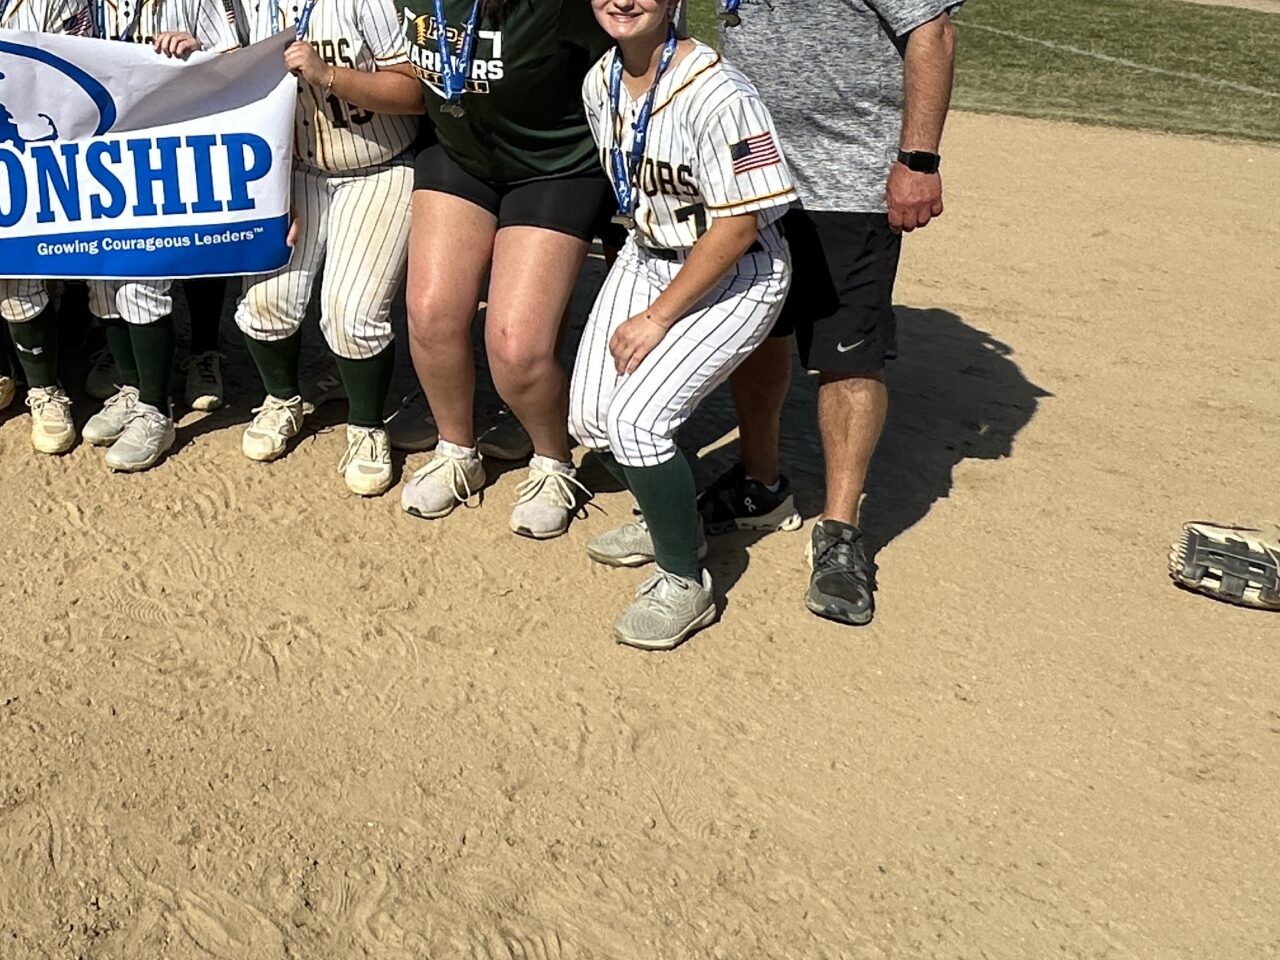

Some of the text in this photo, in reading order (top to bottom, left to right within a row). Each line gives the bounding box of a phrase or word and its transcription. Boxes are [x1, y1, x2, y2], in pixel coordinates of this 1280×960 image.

[674, 202, 708, 243] 7
[37, 240, 99, 257] Growing
[102, 236, 191, 253] Courageous
